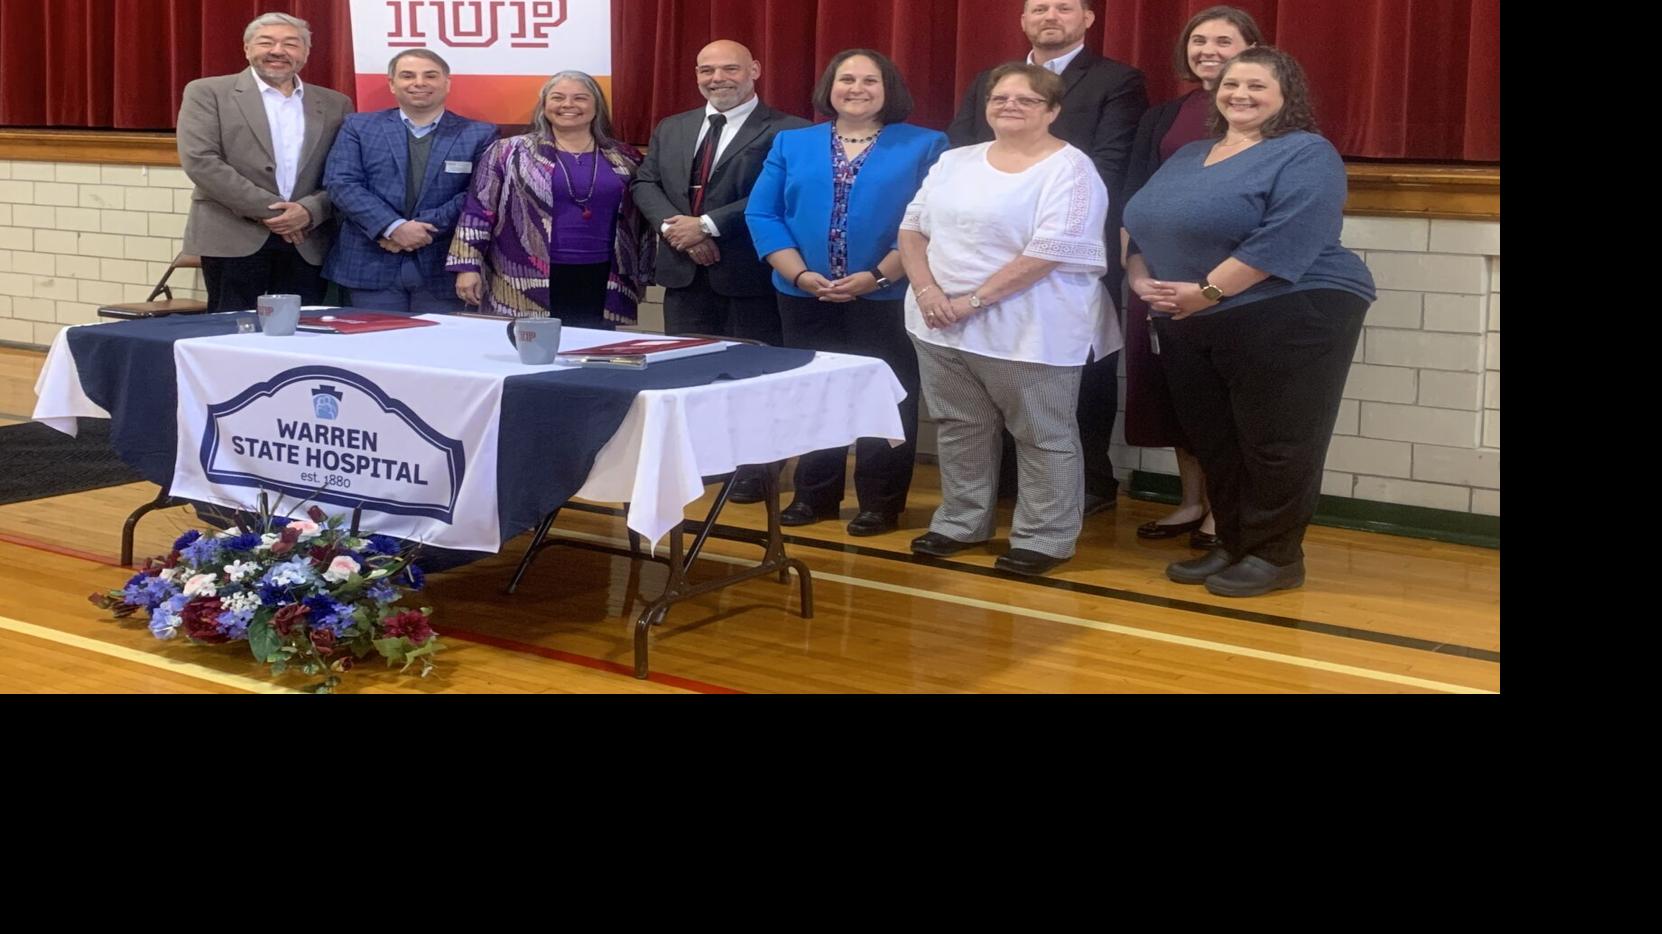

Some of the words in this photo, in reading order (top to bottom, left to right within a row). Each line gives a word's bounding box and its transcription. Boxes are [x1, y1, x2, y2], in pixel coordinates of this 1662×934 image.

[386, 0, 568, 48] IUP
[276, 418, 378, 451] WARREN
[231, 436, 299, 465] STATE
[306, 447, 428, 486] HOSPITAL
[300, 471, 321, 483] est.
[324, 474, 351, 488] 1880
